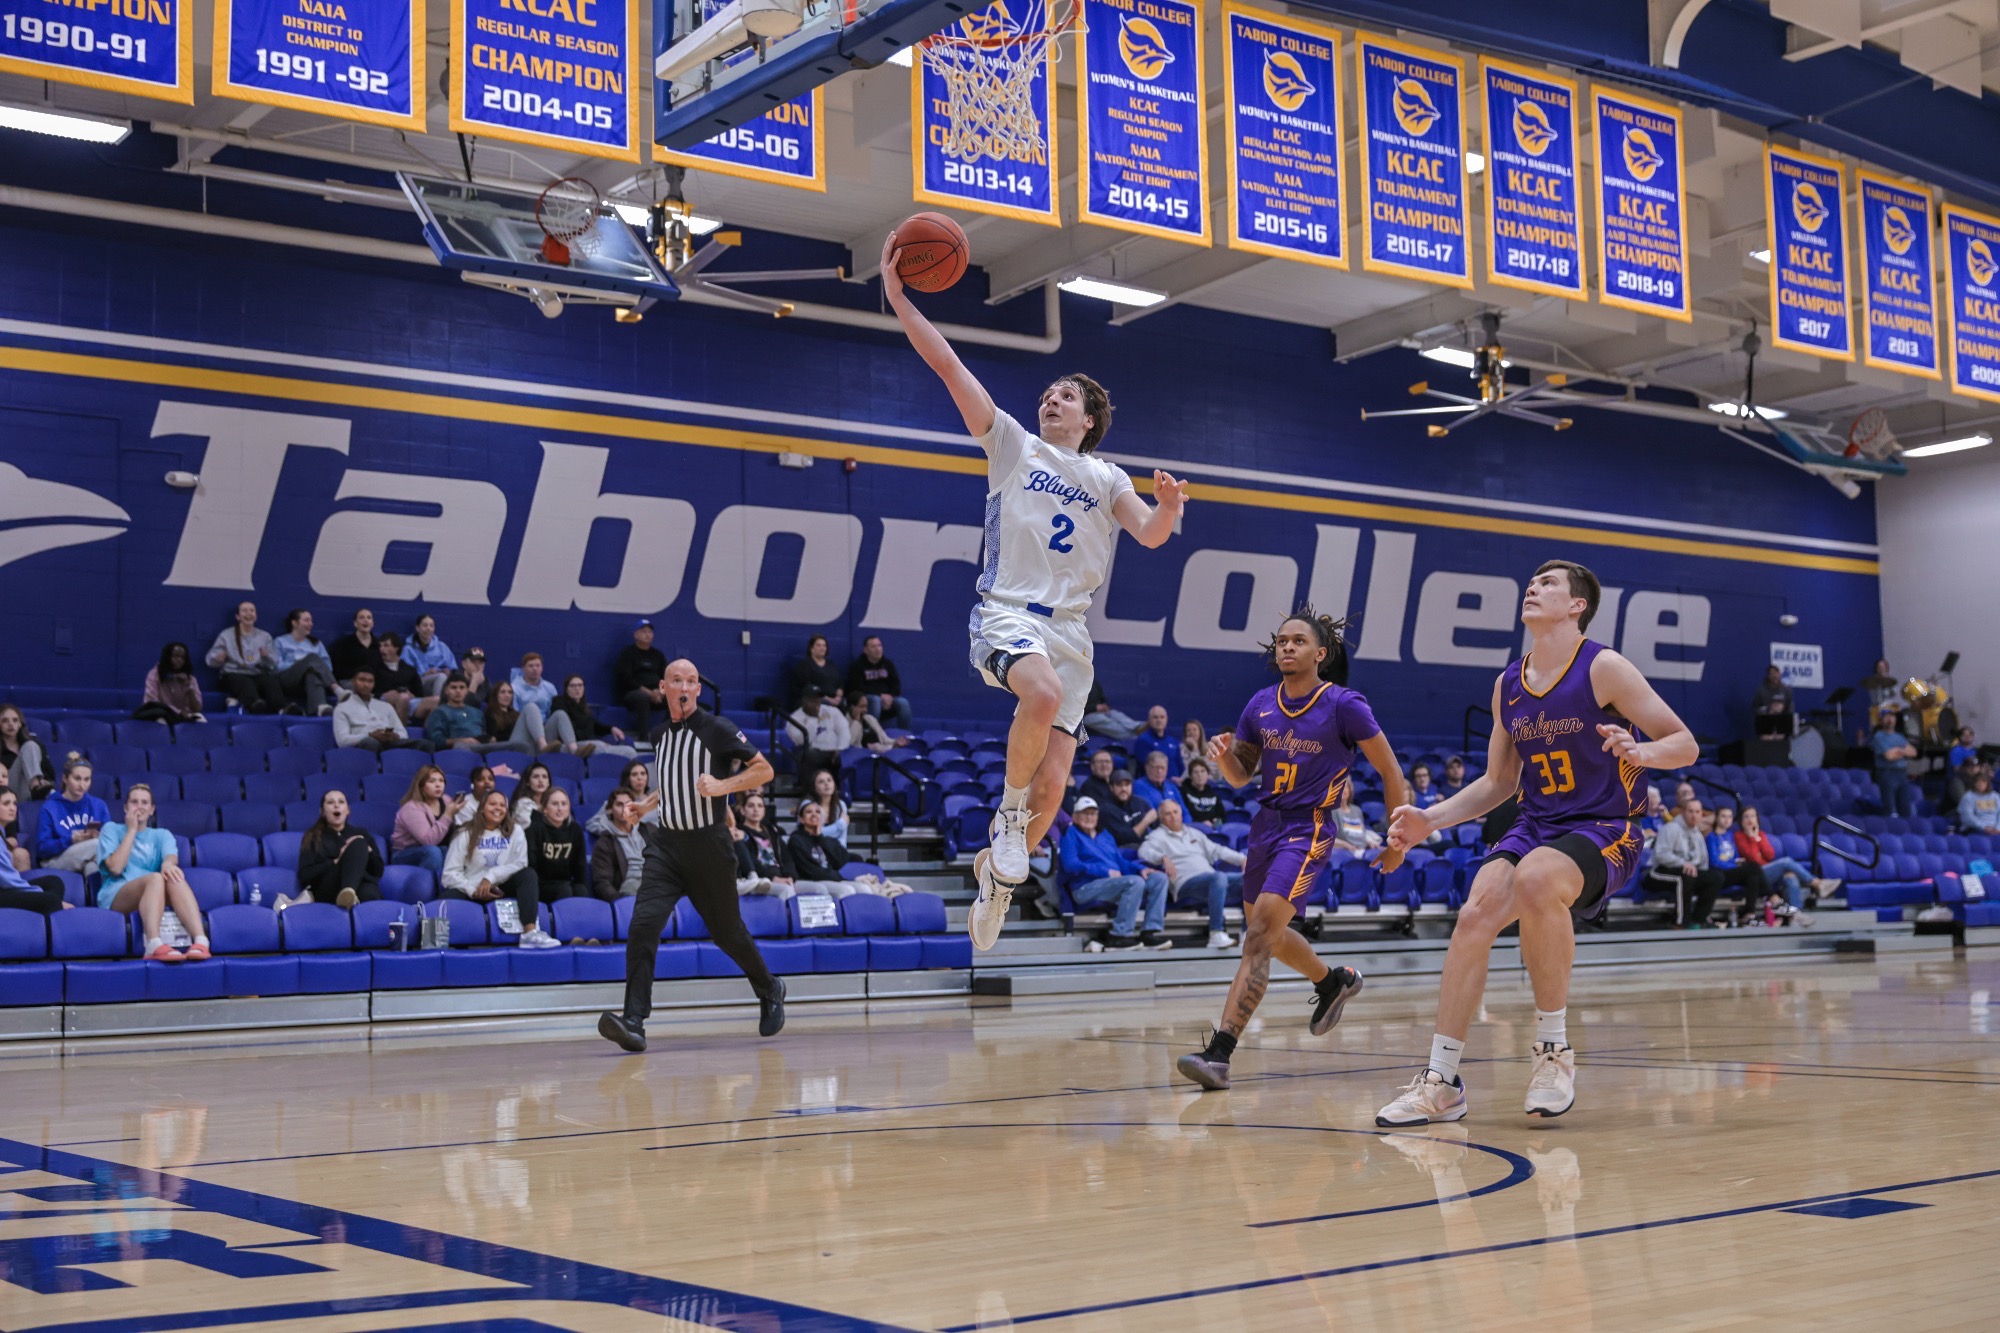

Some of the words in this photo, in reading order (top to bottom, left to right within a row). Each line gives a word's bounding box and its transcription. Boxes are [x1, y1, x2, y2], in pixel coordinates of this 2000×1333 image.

[299, 0, 347, 21] NAIA
[1090, 0, 1134, 12] BOR
[1137, 2, 1192, 27] COLLEGE
[3, 14, 147, 63] 1990-91
[282, 15, 344, 37] DISTRICT
[347, 28, 363, 42] 10
[476, 15, 551, 45] REGULAR
[555, 33, 620, 58] SEASON
[1237, 23, 1277, 46] TABOR
[1281, 36, 1330, 61] COLLEGE
[286, 31, 359, 57] CHAMPION
[930, 47, 975, 63] OMN'S
[472, 43, 623, 95] CHAMPION
[1368, 53, 1406, 74] TABOR
[1408, 64, 1454, 87] COLLEGE
[1091, 71, 1136, 92] WOMEN'S
[1137, 82, 1196, 104] BASKETBALL
[483, 84, 613, 130] 2004-05
[1108, 107, 1146, 126] REGULAR
[1148, 117, 1183, 133] SEASON
[1129, 96, 1160, 114] KCAC
[1239, 104, 1279, 122] WOMEN'S
[1280, 114, 1333, 135] BASKETBALL
[704, 128, 800, 161] 05-06
[1123, 124, 1168, 142] CHAMPION
[1273, 128, 1301, 145] KCAC
[1130, 143, 1161, 161] NAIA
[1239, 147, 1293, 167] TOURNAMENT
[1295, 158, 1336, 177] CHAMPION
[1243, 135, 1280, 153] REGULAR
[1281, 145, 1312, 160] SEASON
[1314, 152, 1332, 165] AND
[944, 160, 1033, 196] 2013-14
[1095, 151, 1137, 170] NATIONAL
[1139, 161, 1198, 181] TOURNAMENT
[1122, 170, 1143, 185] ELITE
[1146, 174, 1171, 189] EIGHT
[1274, 171, 1303, 188] NAIA
[1387, 149, 1444, 184] KCAC
[1241, 180, 1281, 197] NATIONAL
[1283, 189, 1336, 208] TOURNAMENT
[1376, 178, 1457, 208] TOURNAMENT
[1508, 168, 1562, 202] KCAC
[1107, 183, 1189, 218] 2014-15
[1265, 198, 1287, 211] ELITE
[1289, 201, 1312, 215] EIGHT
[1496, 196, 1574, 225] TOURNAMENT
[1619, 193, 1668, 226] KCAC
[1254, 211, 1327, 244] 2015-16
[1373, 201, 1462, 236] CHAMPION
[1387, 233, 1453, 262] 2016-17
[1496, 218, 1577, 251] CHAMPION
[1508, 247, 1570, 277] 2017-18
[1606, 241, 1682, 274] CHAMPION
[1788, 243, 1833, 273] KCAC
[1617, 269, 1674, 298] 2018-19
[1880, 266, 1921, 294] KCAC
[1780, 287, 1845, 317] CHAMPION
[1799, 317, 1830, 340] 2017
[1871, 308, 1934, 337] CHAMPION
[1888, 336, 1919, 358] 2013
[1958, 338, 2000, 363] CHAMPI
[1024, 470, 1100, 512] Bluejays
[150, 400, 983, 632] Tabor
[1048, 513, 1076, 554] 2
[1511, 710, 1584, 745] Wesleyan
[1261, 728, 1323, 758] Wesleyan
[1271, 762, 1298, 795] 21
[1530, 750, 1576, 796] 33
[60, 812, 94, 830] TABO
